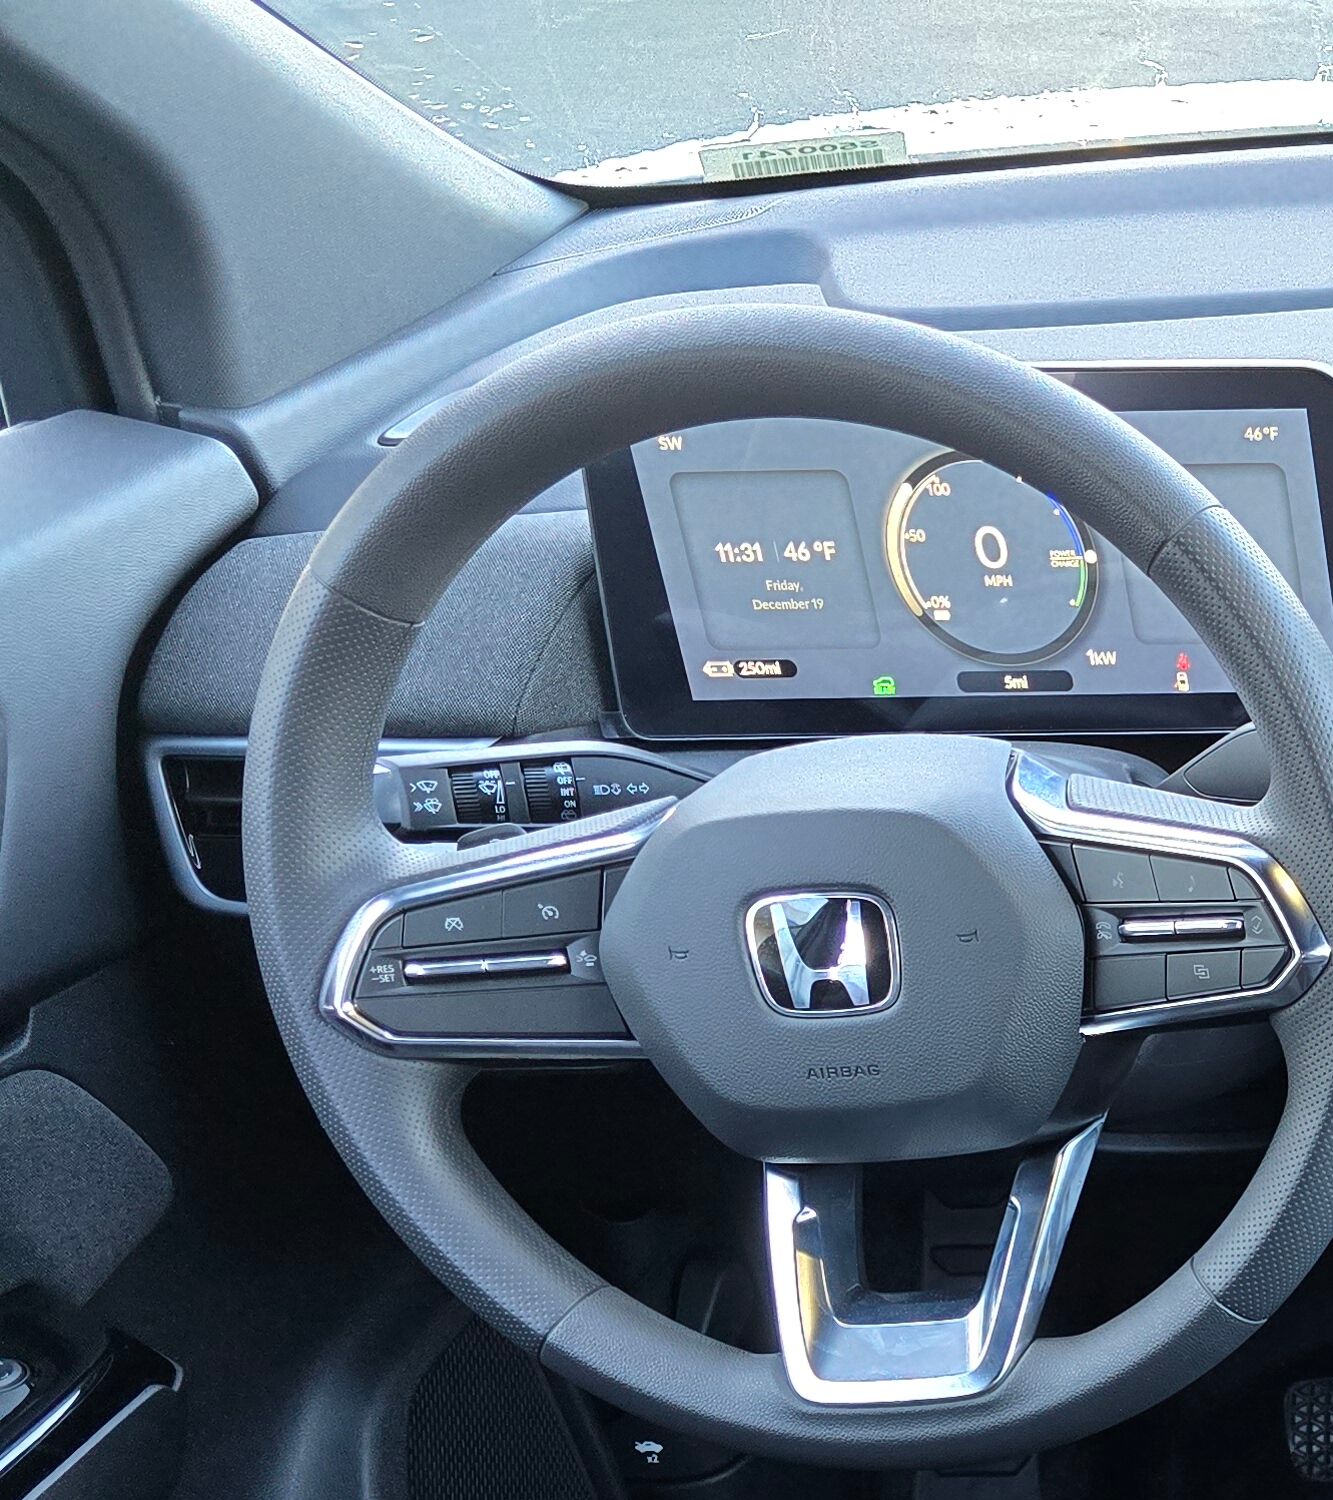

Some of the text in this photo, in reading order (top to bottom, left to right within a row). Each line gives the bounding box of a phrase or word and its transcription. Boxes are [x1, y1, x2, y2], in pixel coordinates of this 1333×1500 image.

[1244, 426, 1279, 442] 46°F
[657, 435, 683, 451] SW
[928, 482, 951, 497] 100
[908, 528, 926, 543] 50
[715, 541, 764, 563] 11:31
[974, 525, 1009, 569] 0
[984, 574, 1013, 588] MPH
[752, 598, 824, 612] December 19
[930, 595, 951, 609] 0%
[738, 660, 782, 677] 250mi
[1004, 675, 1030, 690] 5mi
[483, 769, 501, 779] OFF
[557, 776, 573, 786] OFF
[560, 787, 575, 797] INT
[495, 805, 506, 814] LO
[564, 800, 576, 808] ON
[805, 1064, 881, 1080] AIRBAG
